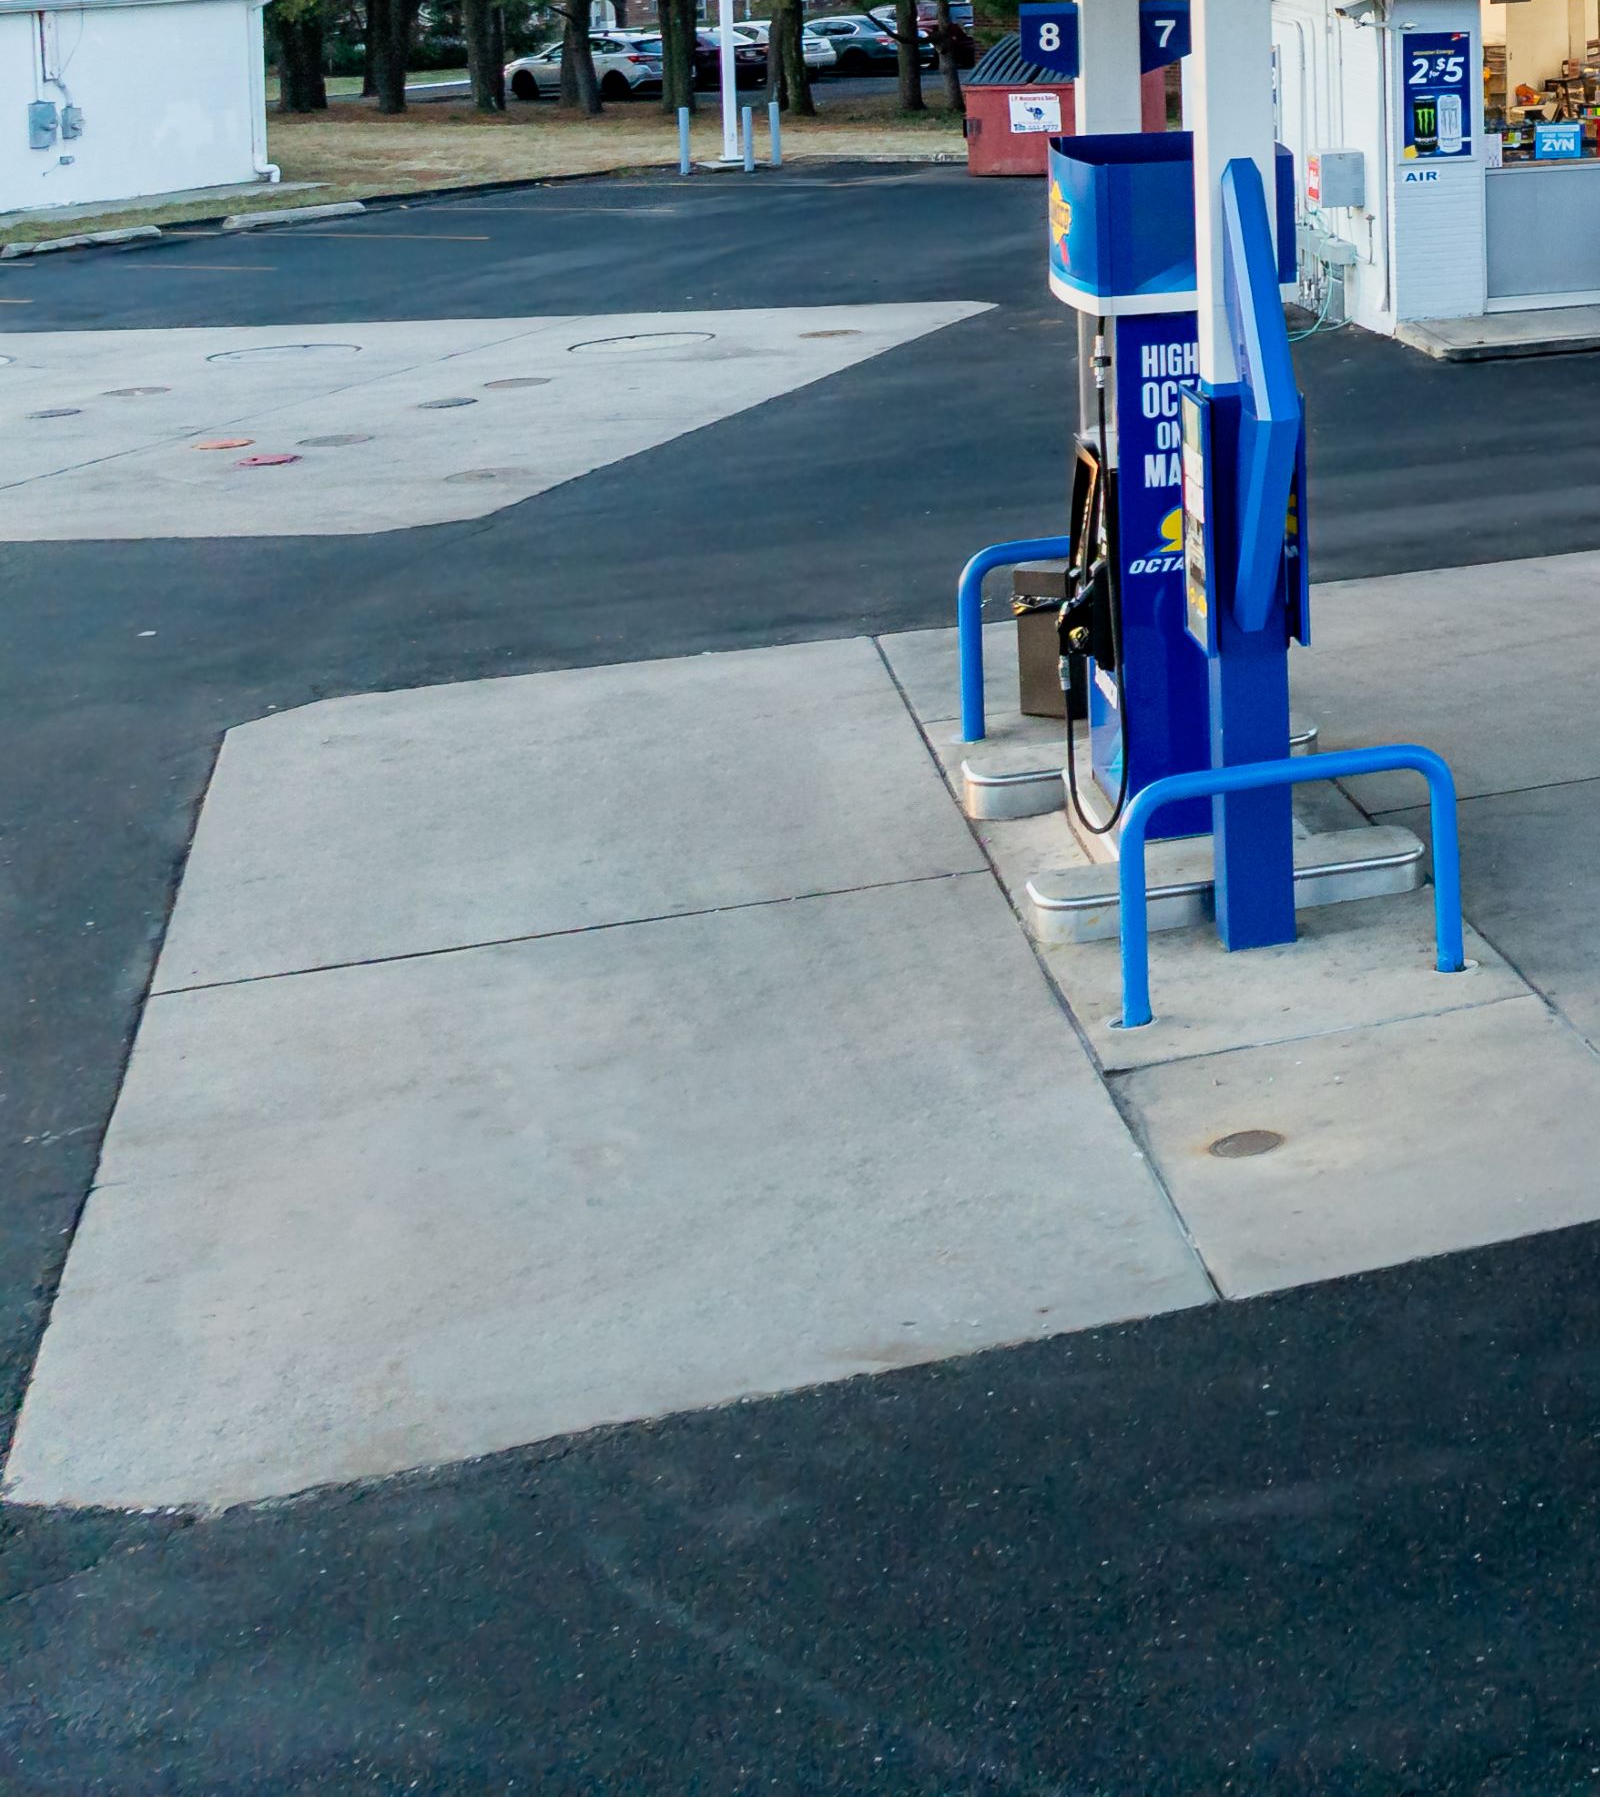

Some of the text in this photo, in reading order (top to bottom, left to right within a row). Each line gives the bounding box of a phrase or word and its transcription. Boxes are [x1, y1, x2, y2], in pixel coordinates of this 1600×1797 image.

[1038, 22, 1061, 52] 8
[1154, 19, 1176, 48] 7
[1409, 58, 1429, 85] 2
[1436, 56, 1465, 83] $5
[1542, 138, 1576, 152] ZYN
[1405, 171, 1438, 182] AIR
[1141, 342, 1200, 378] HIGH
[1128, 556, 1185, 575] OCTA
